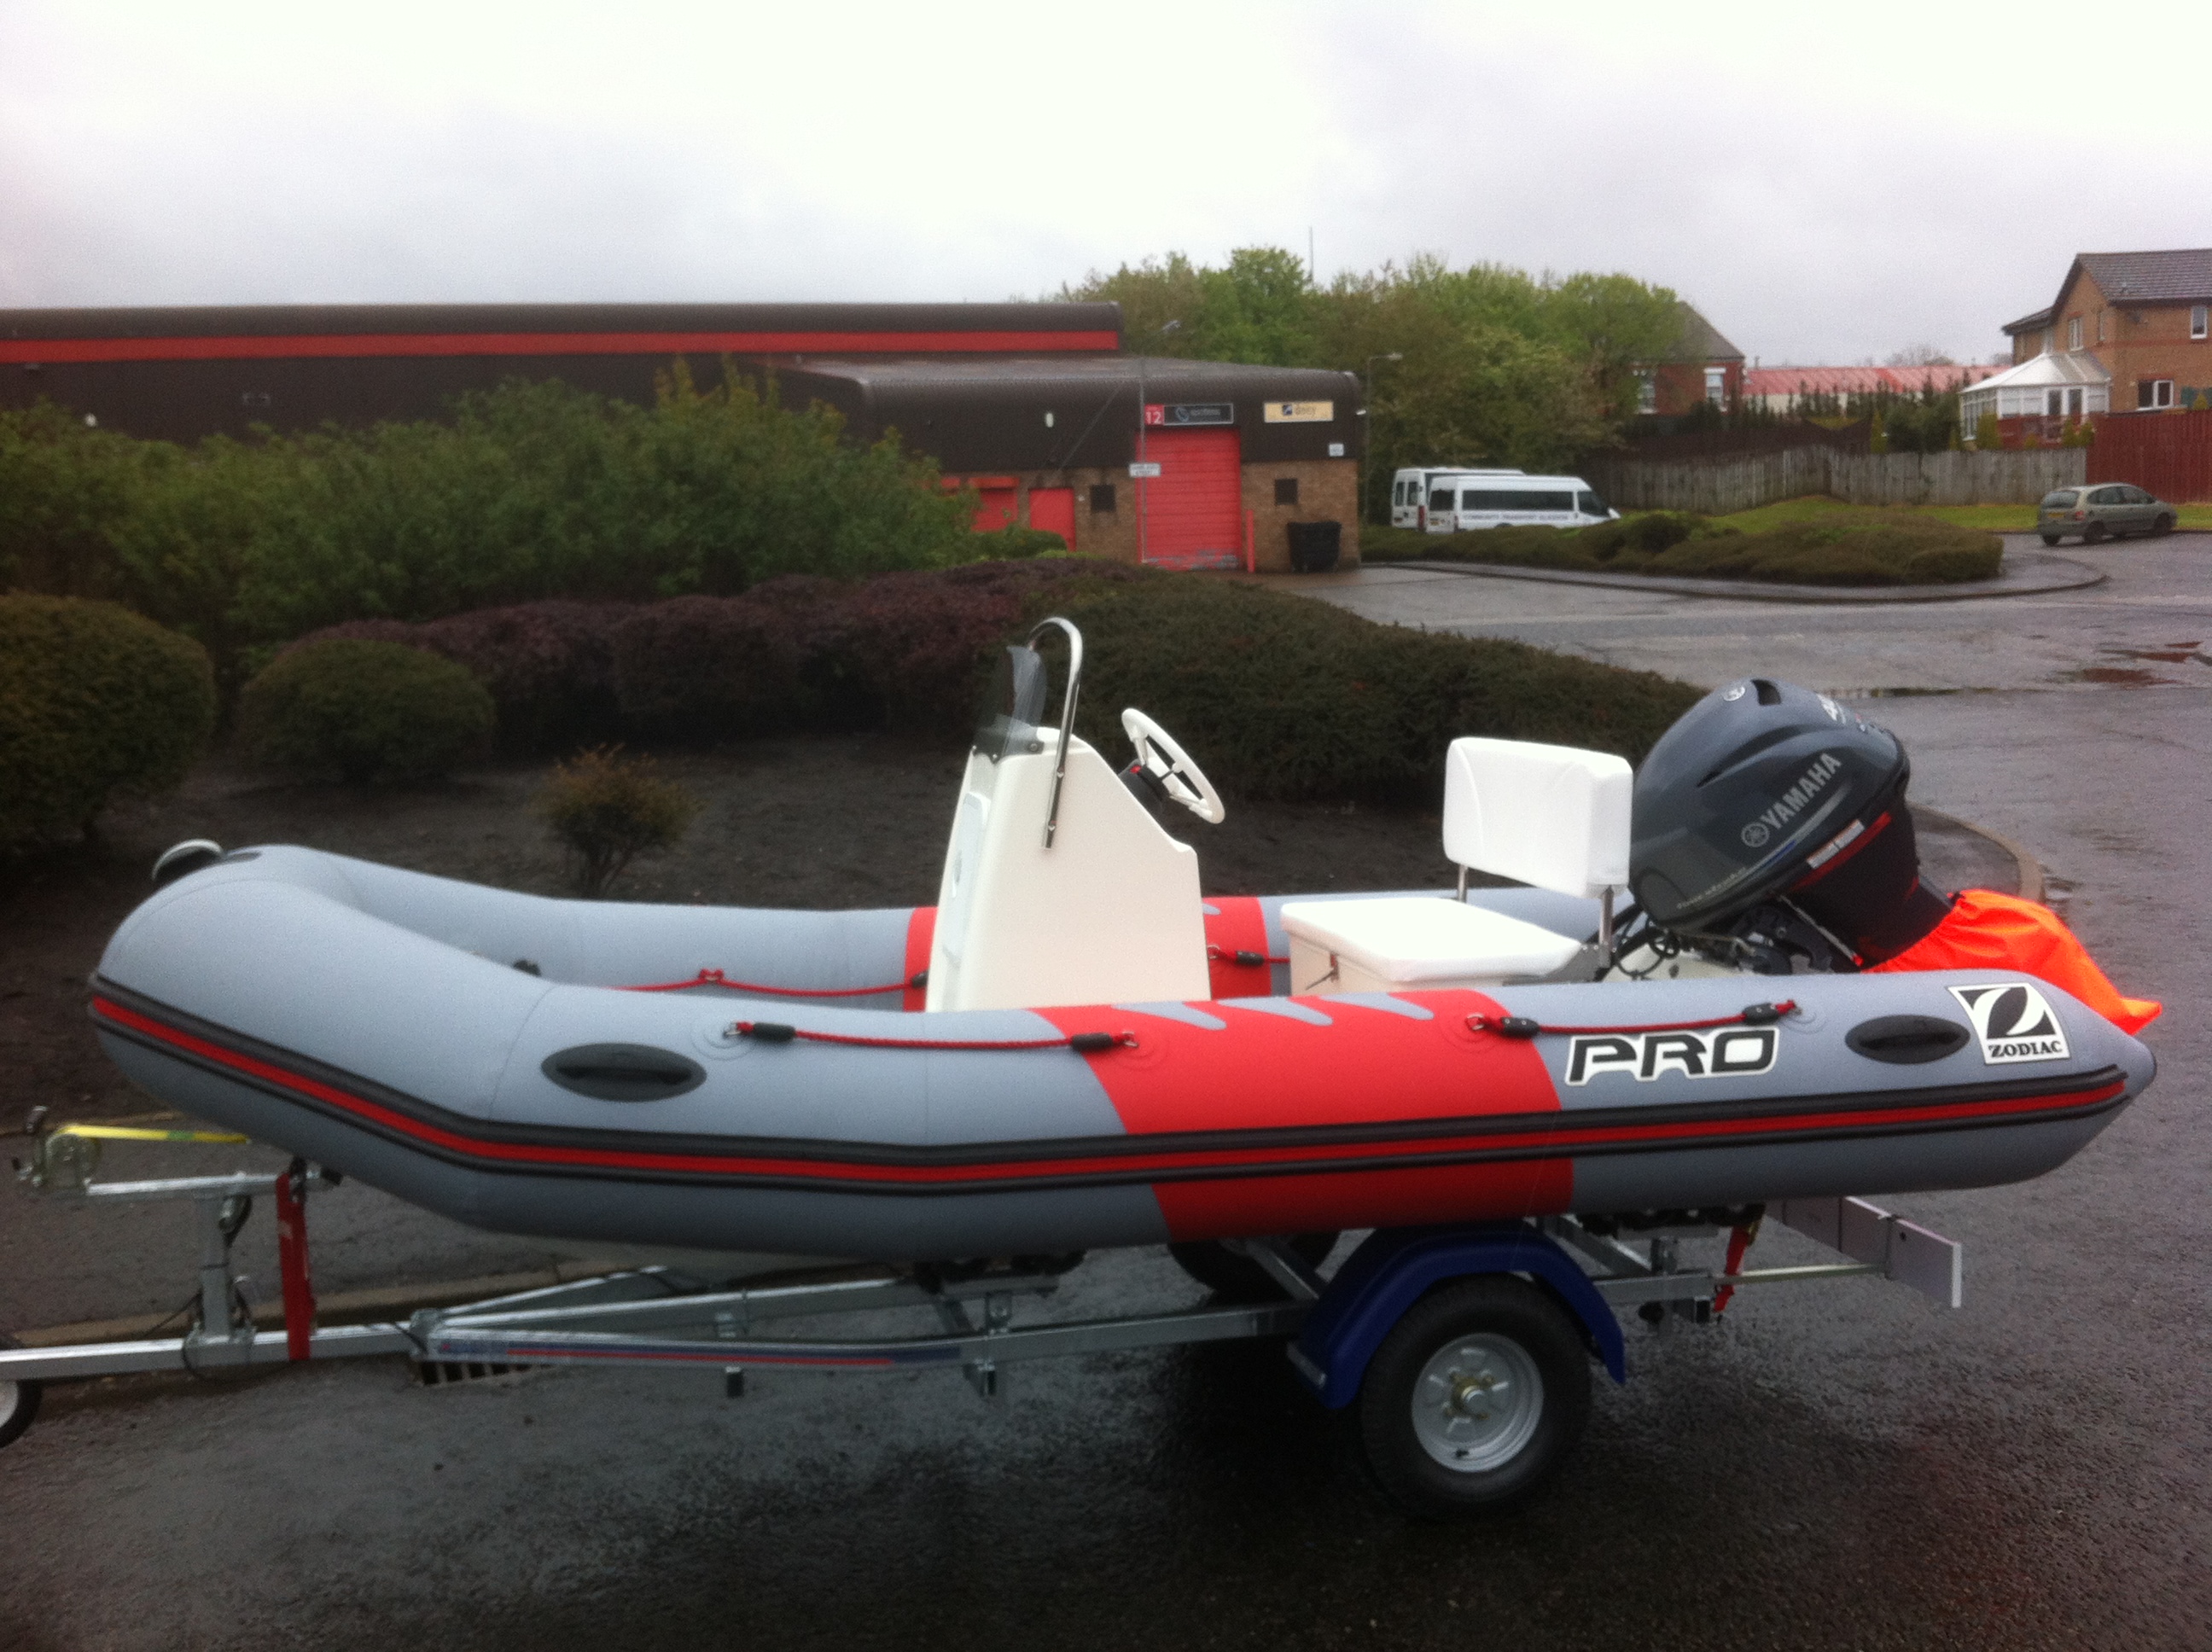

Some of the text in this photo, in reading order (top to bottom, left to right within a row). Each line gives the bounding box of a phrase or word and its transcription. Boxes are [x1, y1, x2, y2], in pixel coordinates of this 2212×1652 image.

[1145, 411, 1161, 424] 12
[1760, 753, 1842, 830] YAMAHA
[1569, 1029, 1777, 1083] PRO
[1988, 1040, 2064, 1058] ZODIAC
